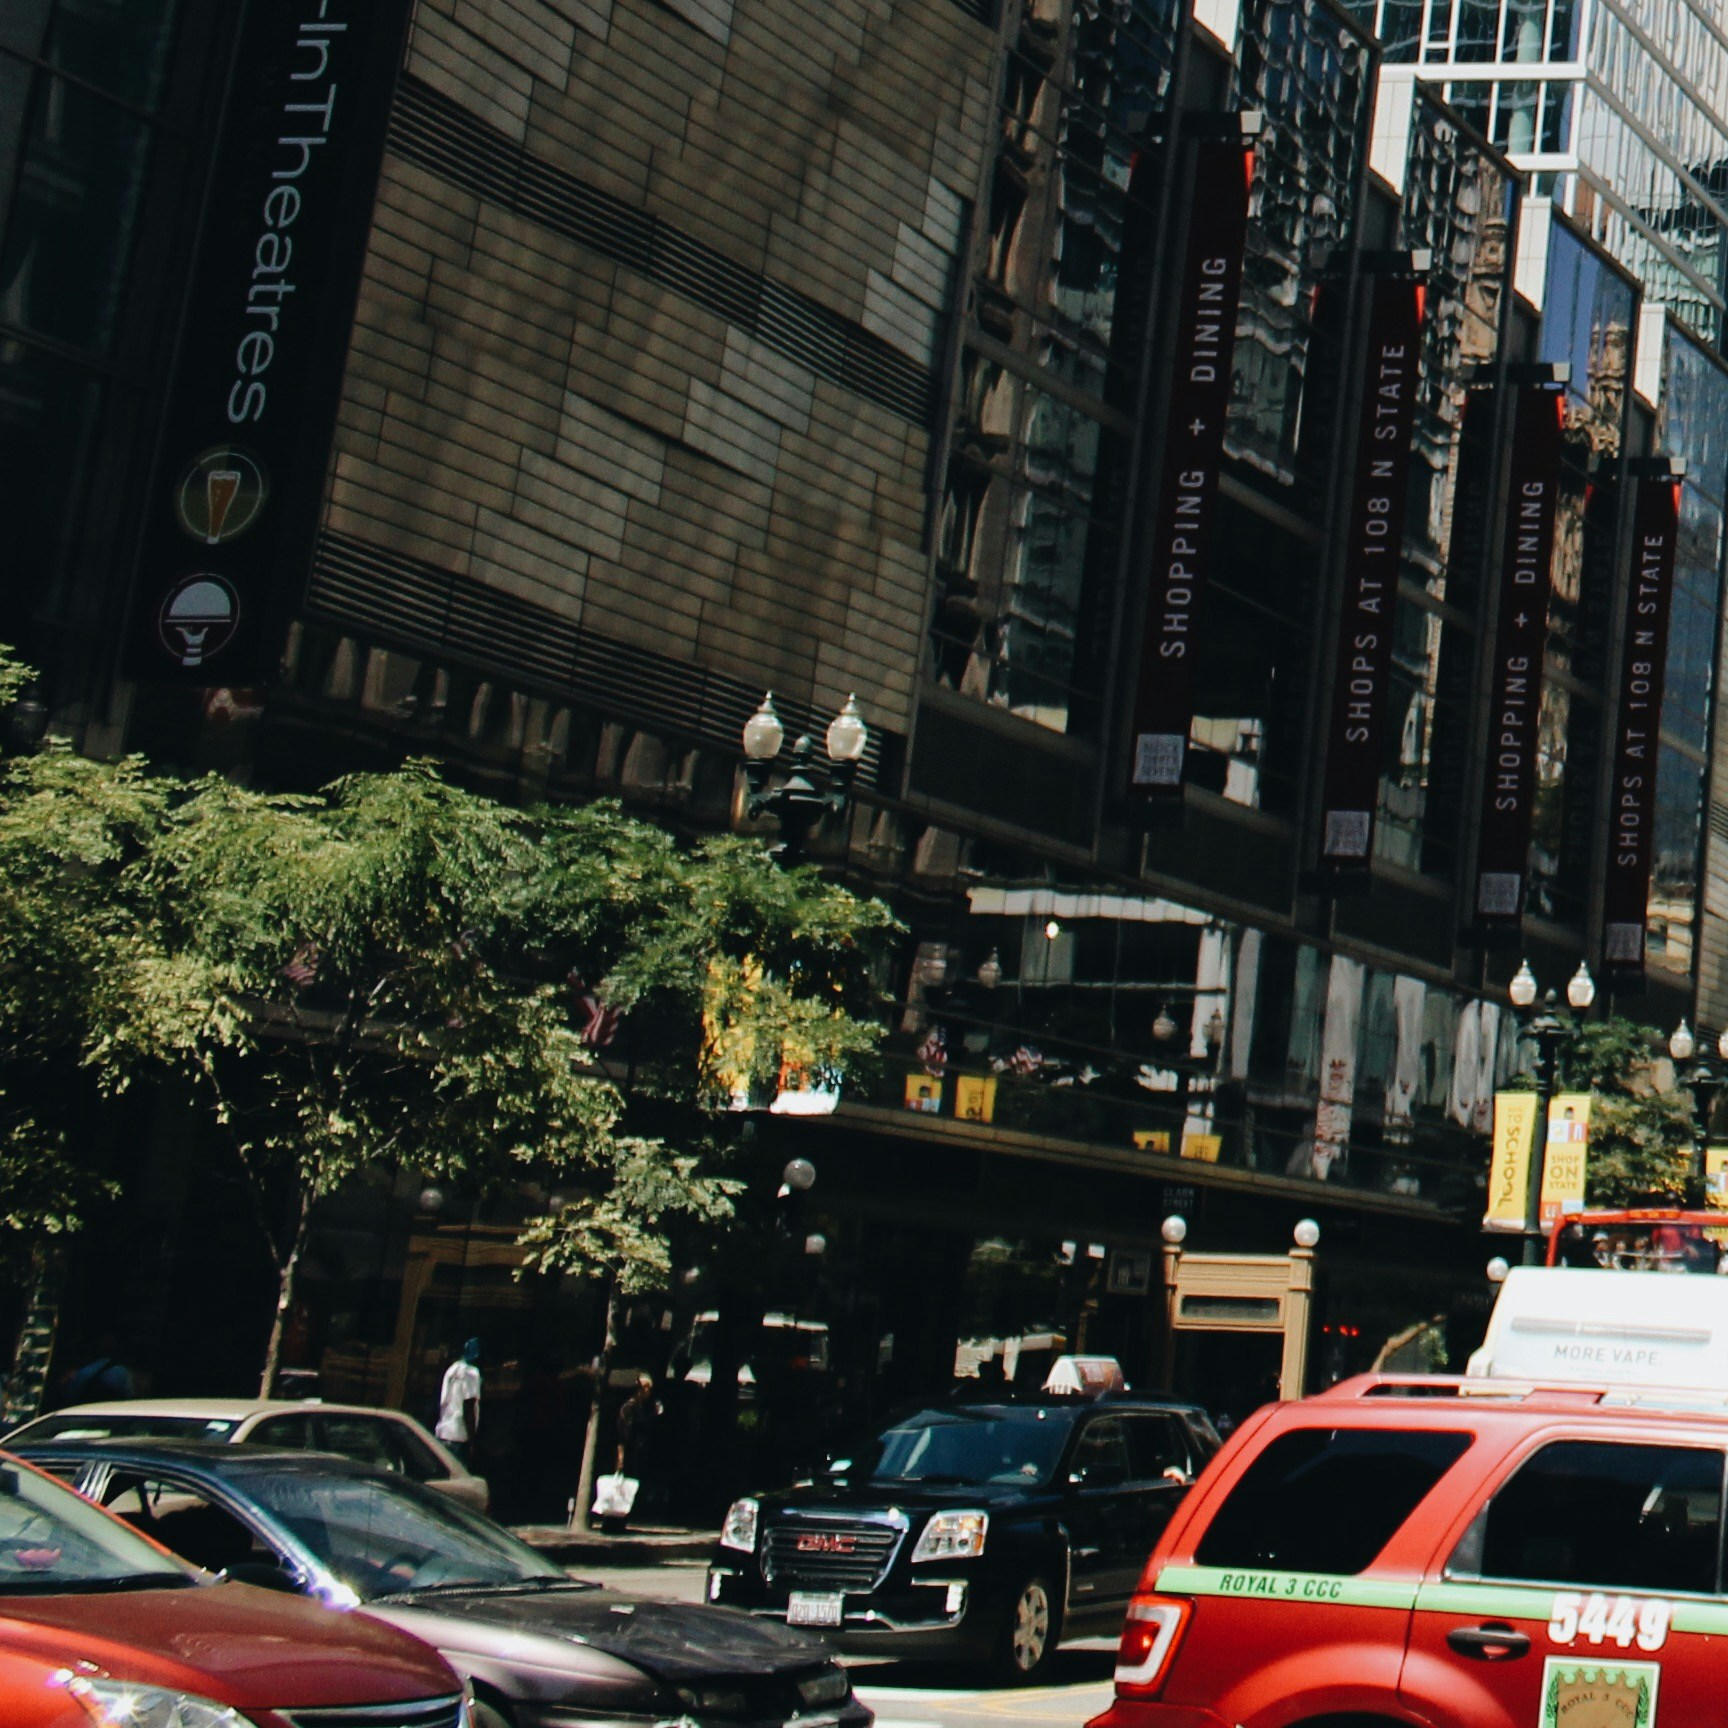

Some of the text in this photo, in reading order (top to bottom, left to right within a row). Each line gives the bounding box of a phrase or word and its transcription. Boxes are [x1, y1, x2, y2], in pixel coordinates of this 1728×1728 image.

[226, 84, 338, 425] Theatres
[1159, 470, 1205, 658] SHOPPING
[1190, 258, 1226, 382] DINING
[1345, 345, 1405, 742] SHOPS AT 108 N STATE
[1495, 657, 1529, 810] SHOPPING
[1514, 482, 1544, 584] DINING
[1617, 535, 1663, 866] SHOPS AT 108 N STATE
[1498, 1126, 1520, 1207] SCHOOL
[1550, 1165, 1577, 1179] ON
[1552, 1155, 1580, 1164] SHOP
[1549, 1182, 1577, 1190] STATE
[1555, 1344, 1605, 1363] MORE
[797, 1534, 857, 1553] GMC
[1219, 1573, 1277, 1594] ROYAL
[1285, 1578, 1297, 1596] 3
[1547, 1591, 1671, 1652] 5449
[1560, 1691, 1596, 1715] ROYAL
